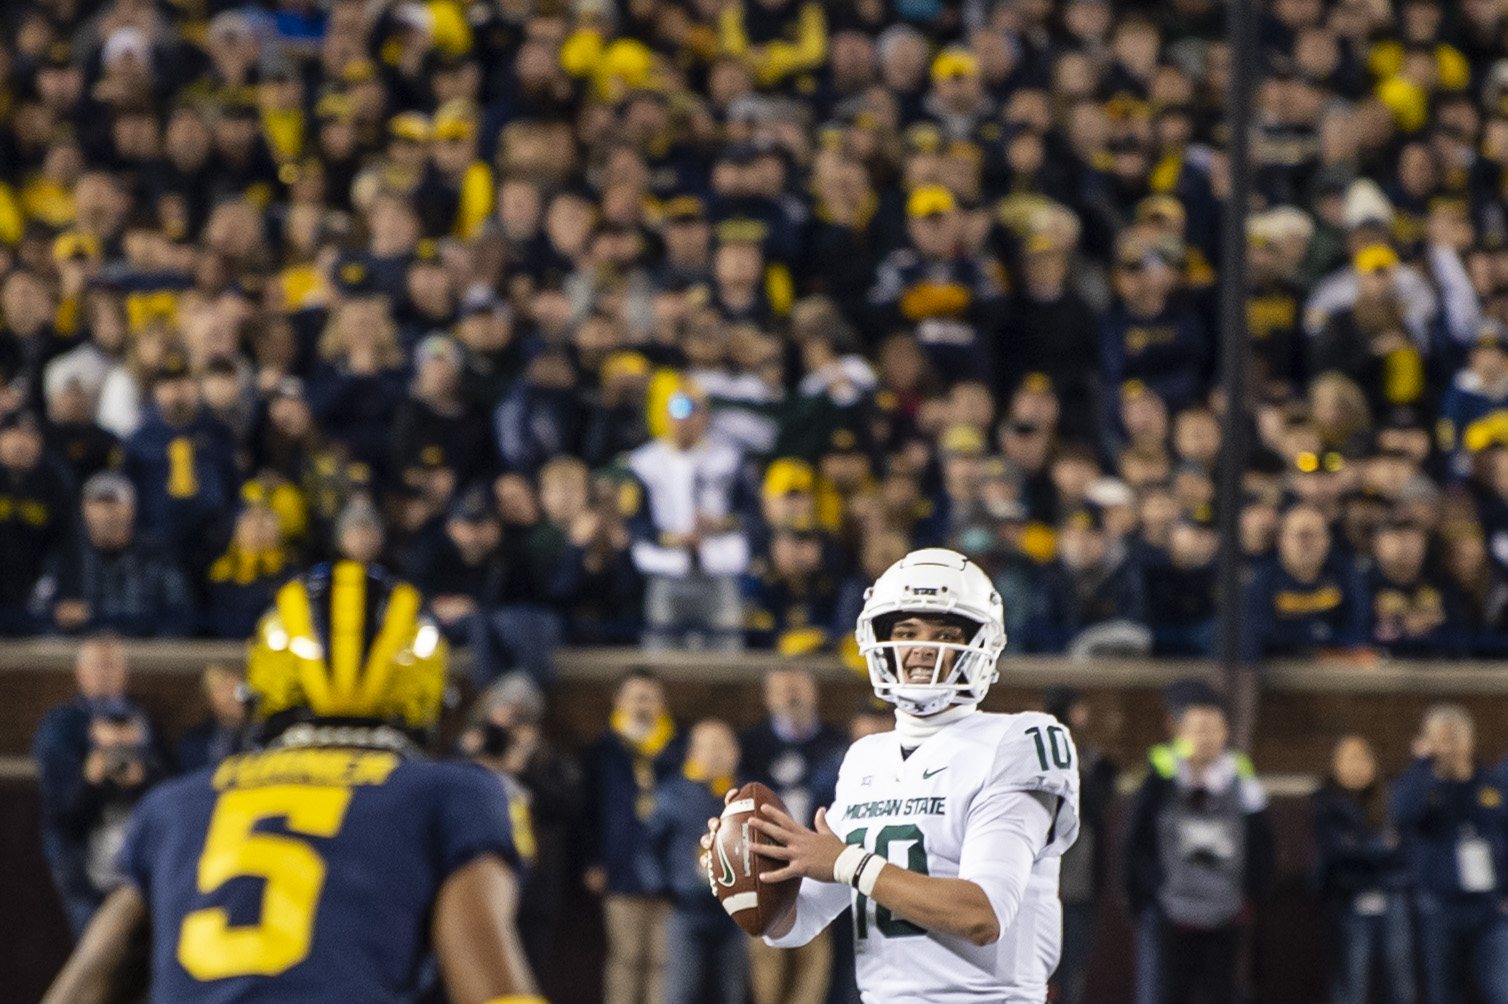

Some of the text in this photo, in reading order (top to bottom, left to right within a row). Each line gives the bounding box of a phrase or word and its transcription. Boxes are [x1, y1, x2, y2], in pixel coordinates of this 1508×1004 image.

[1024, 725, 1071, 771] 10
[842, 797, 946, 820] MICHIGAN STATE
[177, 784, 354, 982] 5
[846, 824, 928, 939] 10
